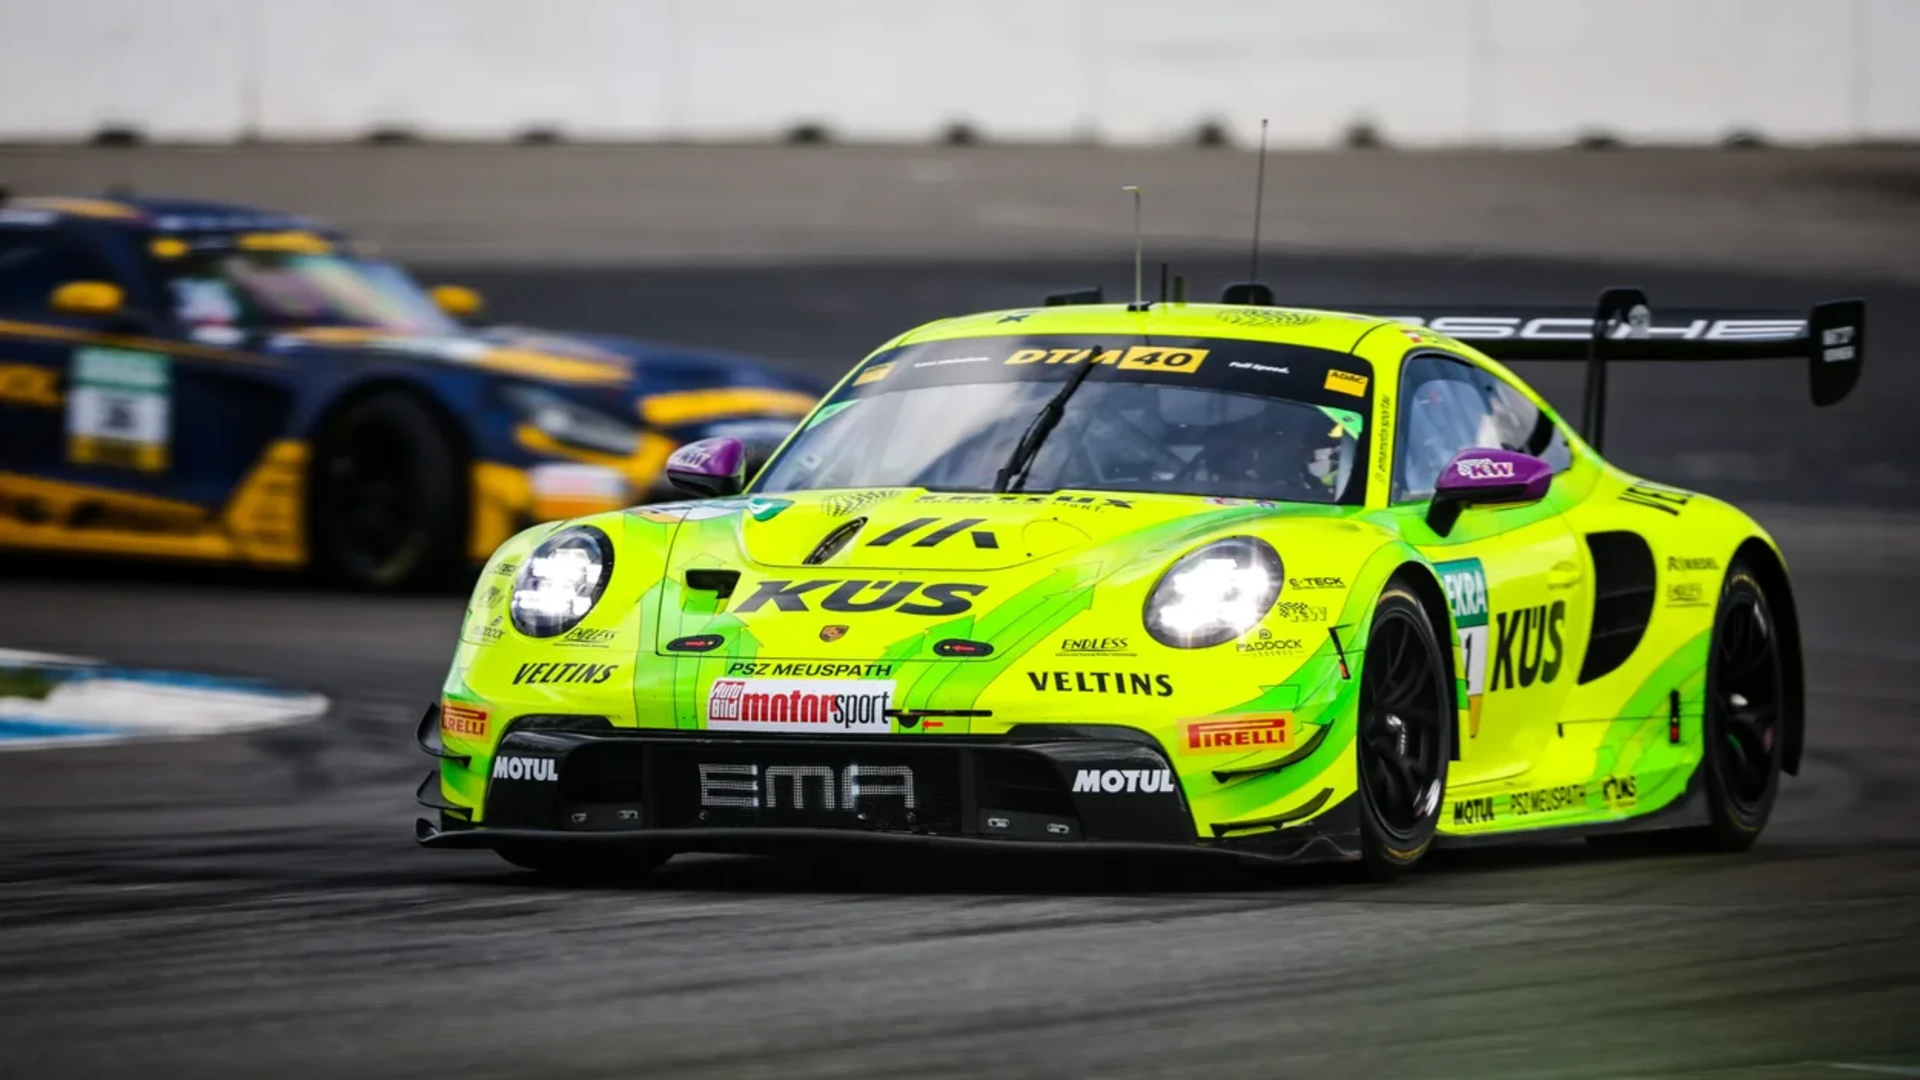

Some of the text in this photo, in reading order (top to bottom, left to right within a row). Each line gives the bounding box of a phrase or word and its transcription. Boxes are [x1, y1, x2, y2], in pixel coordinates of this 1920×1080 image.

[1003, 348, 1122, 365] DTM
[1134, 352, 1194, 368] 40
[1331, 370, 1364, 385] ADAC
[733, 579, 988, 615] KÜS
[1444, 570, 1487, 617] EKRA
[1061, 637, 1129, 650] ENDLESS
[1236, 639, 1303, 652] PADDOCK
[1490, 600, 1566, 692] KÜS
[512, 663, 619, 685] VELTINS
[728, 663, 892, 677] PSZ MEUSPATH
[713, 682, 744, 699] Auto
[1027, 671, 1173, 697] VELTINS
[711, 699, 739, 719] Bild
[741, 690, 889, 728] motorsport
[1188, 718, 1285, 748] PIRELLI
[493, 756, 558, 781] MOTUL
[699, 764, 915, 809] EMA
[1072, 769, 1175, 793] MOTUL
[1454, 797, 1495, 824] MOTUL
